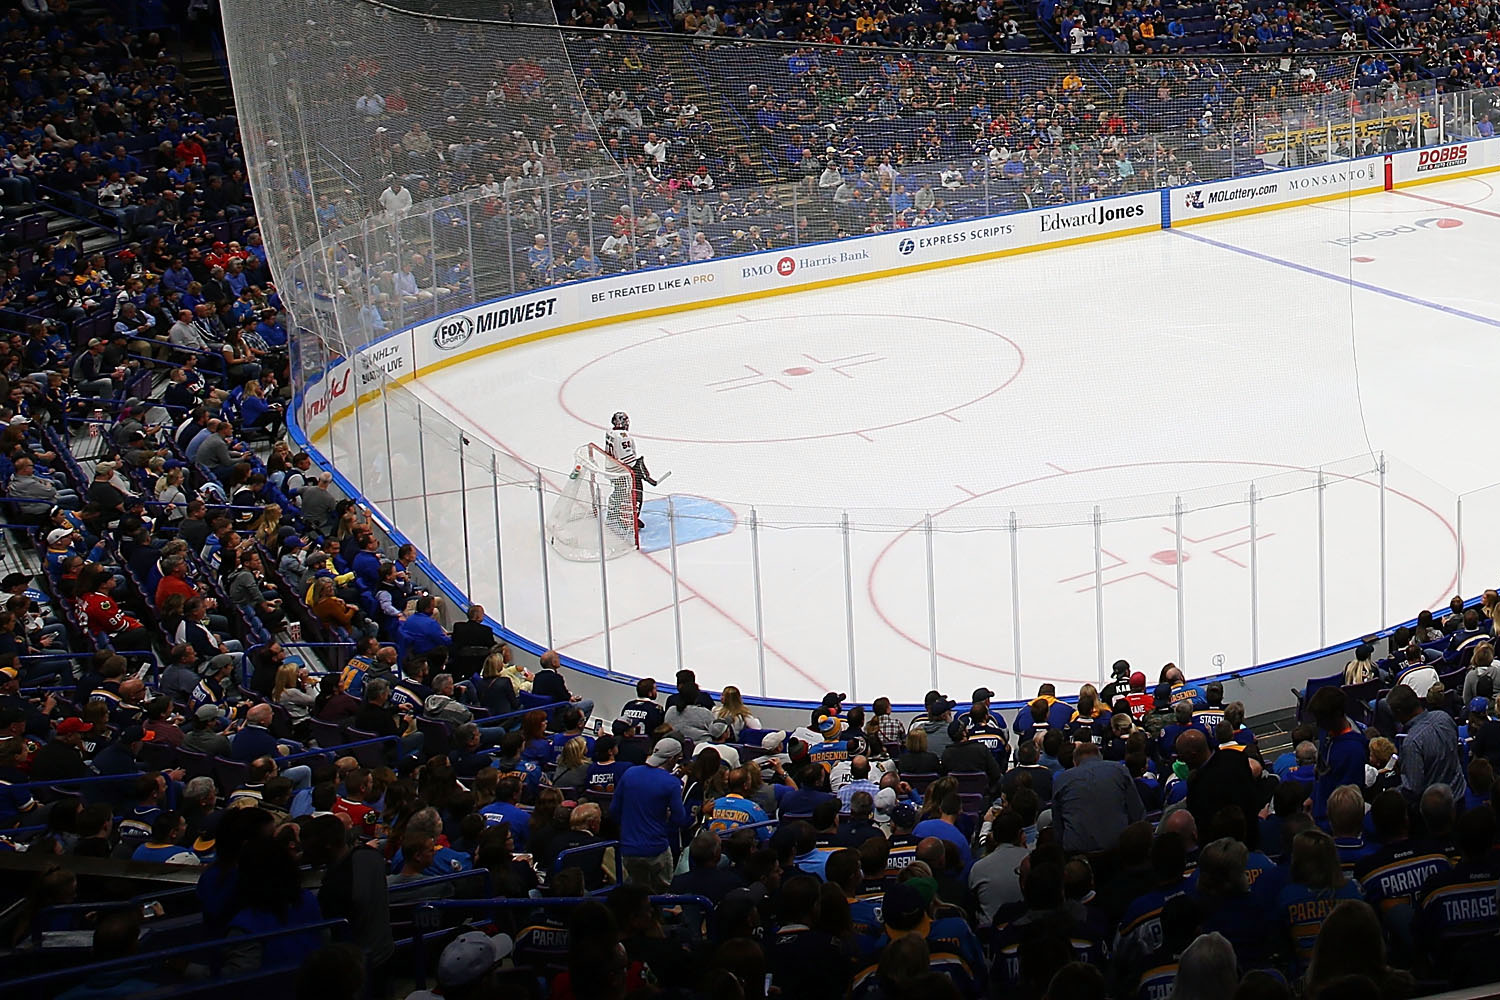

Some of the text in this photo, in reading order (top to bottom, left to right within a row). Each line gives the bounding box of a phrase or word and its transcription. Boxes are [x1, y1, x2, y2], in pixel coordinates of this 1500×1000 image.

[1418, 144, 1469, 165] DOBBS
[1288, 167, 1366, 192] MONSANTO
[1208, 181, 1279, 205] MOLottery.com
[1040, 203, 1145, 233] Edward Jones
[919, 223, 1014, 249] EXPRESS SCRIPTS
[1325, 221, 1418, 248] pepsi
[742, 247, 870, 280] BMO Harris Bank
[591, 273, 716, 304] BE TREATED LIKE A PRO
[475, 298, 557, 334] MIDWEST
[440, 321, 465, 338] FOX
[441, 331, 466, 345] SPORTS
[387, 356, 404, 373] LIVE
[1115, 685, 1132, 695] KAN
[810, 751, 849, 764] TARASENKO
[589, 773, 615, 785] JOSEPH
[1443, 898, 1498, 922] TARASE
[532, 929, 569, 947] PARAY
